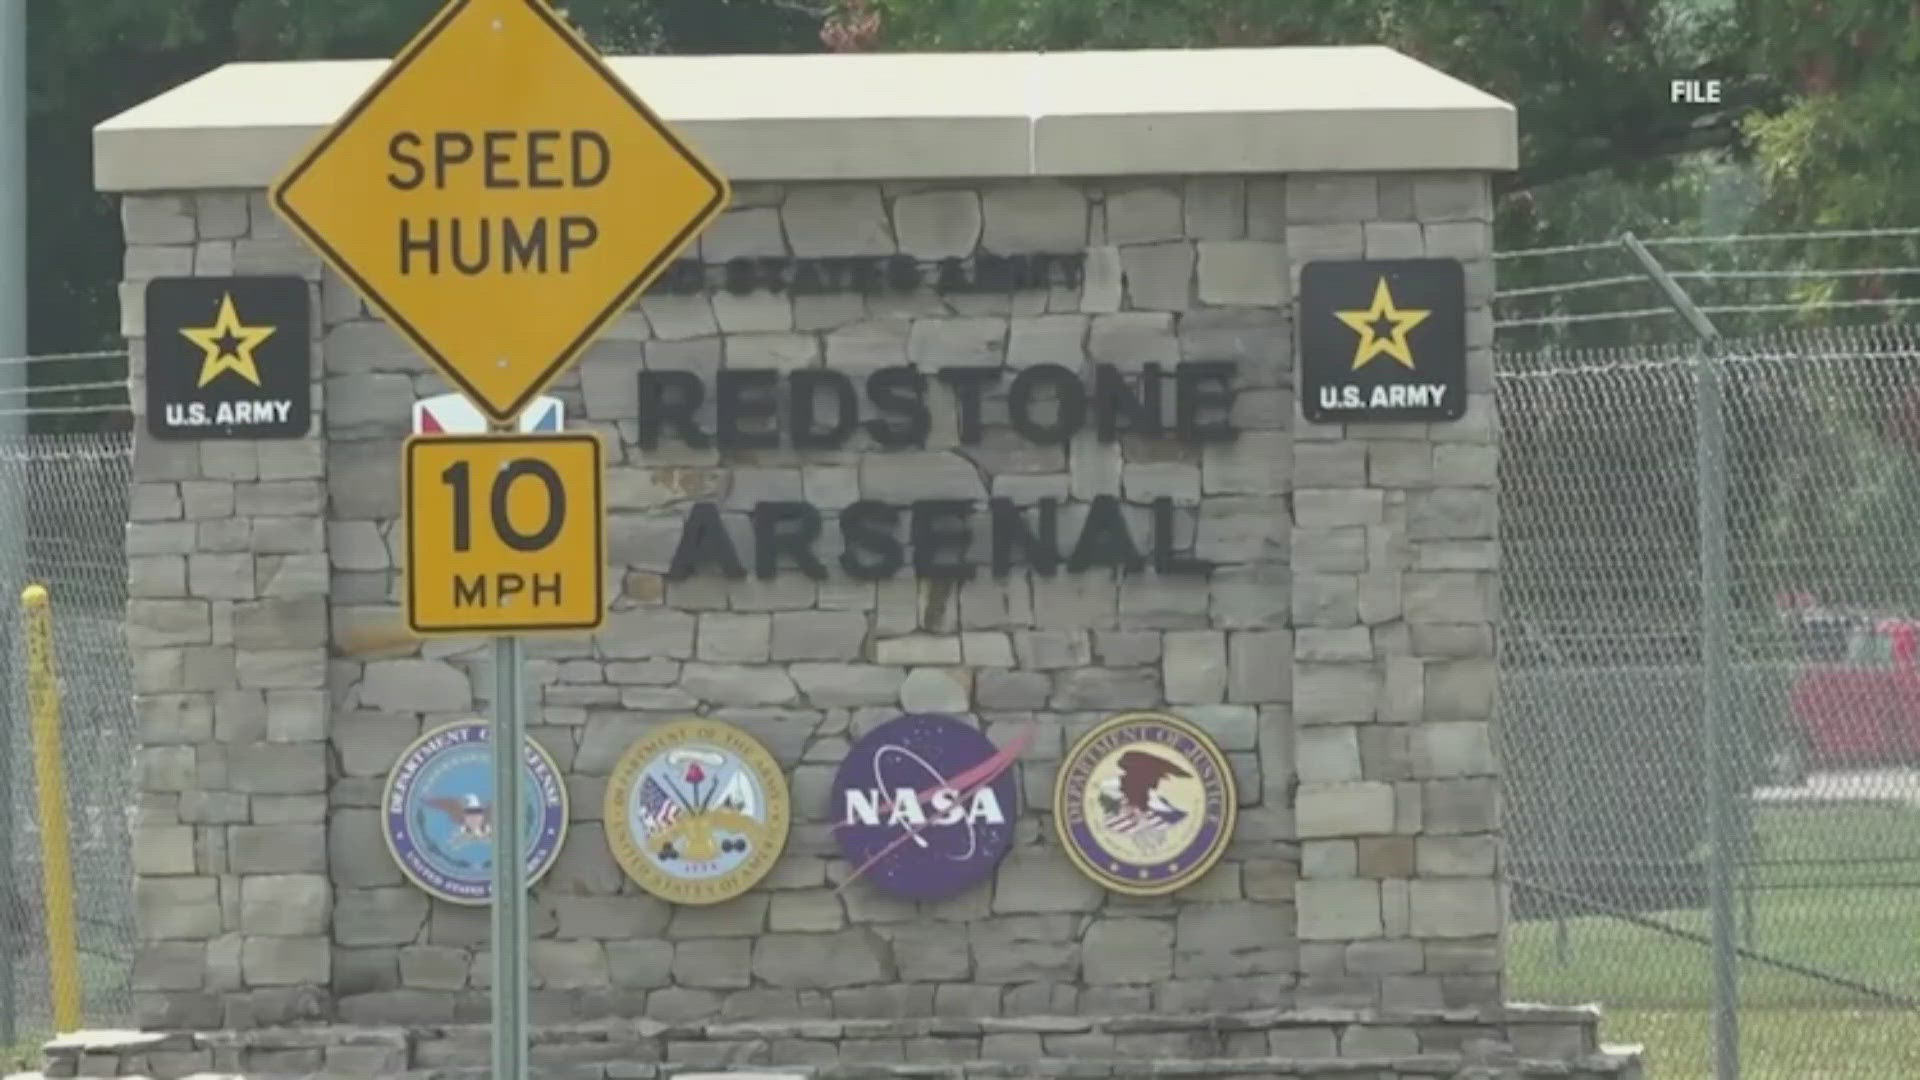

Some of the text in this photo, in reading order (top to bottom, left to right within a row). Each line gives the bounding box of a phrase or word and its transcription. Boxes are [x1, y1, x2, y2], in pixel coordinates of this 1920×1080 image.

[387, 131, 611, 190] SPEED
[399, 216, 598, 275] HUMP
[165, 400, 292, 426] U.S. ARMY
[637, 362, 1240, 452] REDSTONE
[1320, 383, 1447, 409] U.S. ARMY
[441, 458, 567, 552] 10
[668, 496, 1214, 582] ARSENAL
[454, 573, 562, 607] MPH
[390, 728, 469, 815] DEPARTMENT
[1067, 726, 1222, 823] DEPARTMENT OF JUSTICE
[845, 787, 1005, 826] NASA
